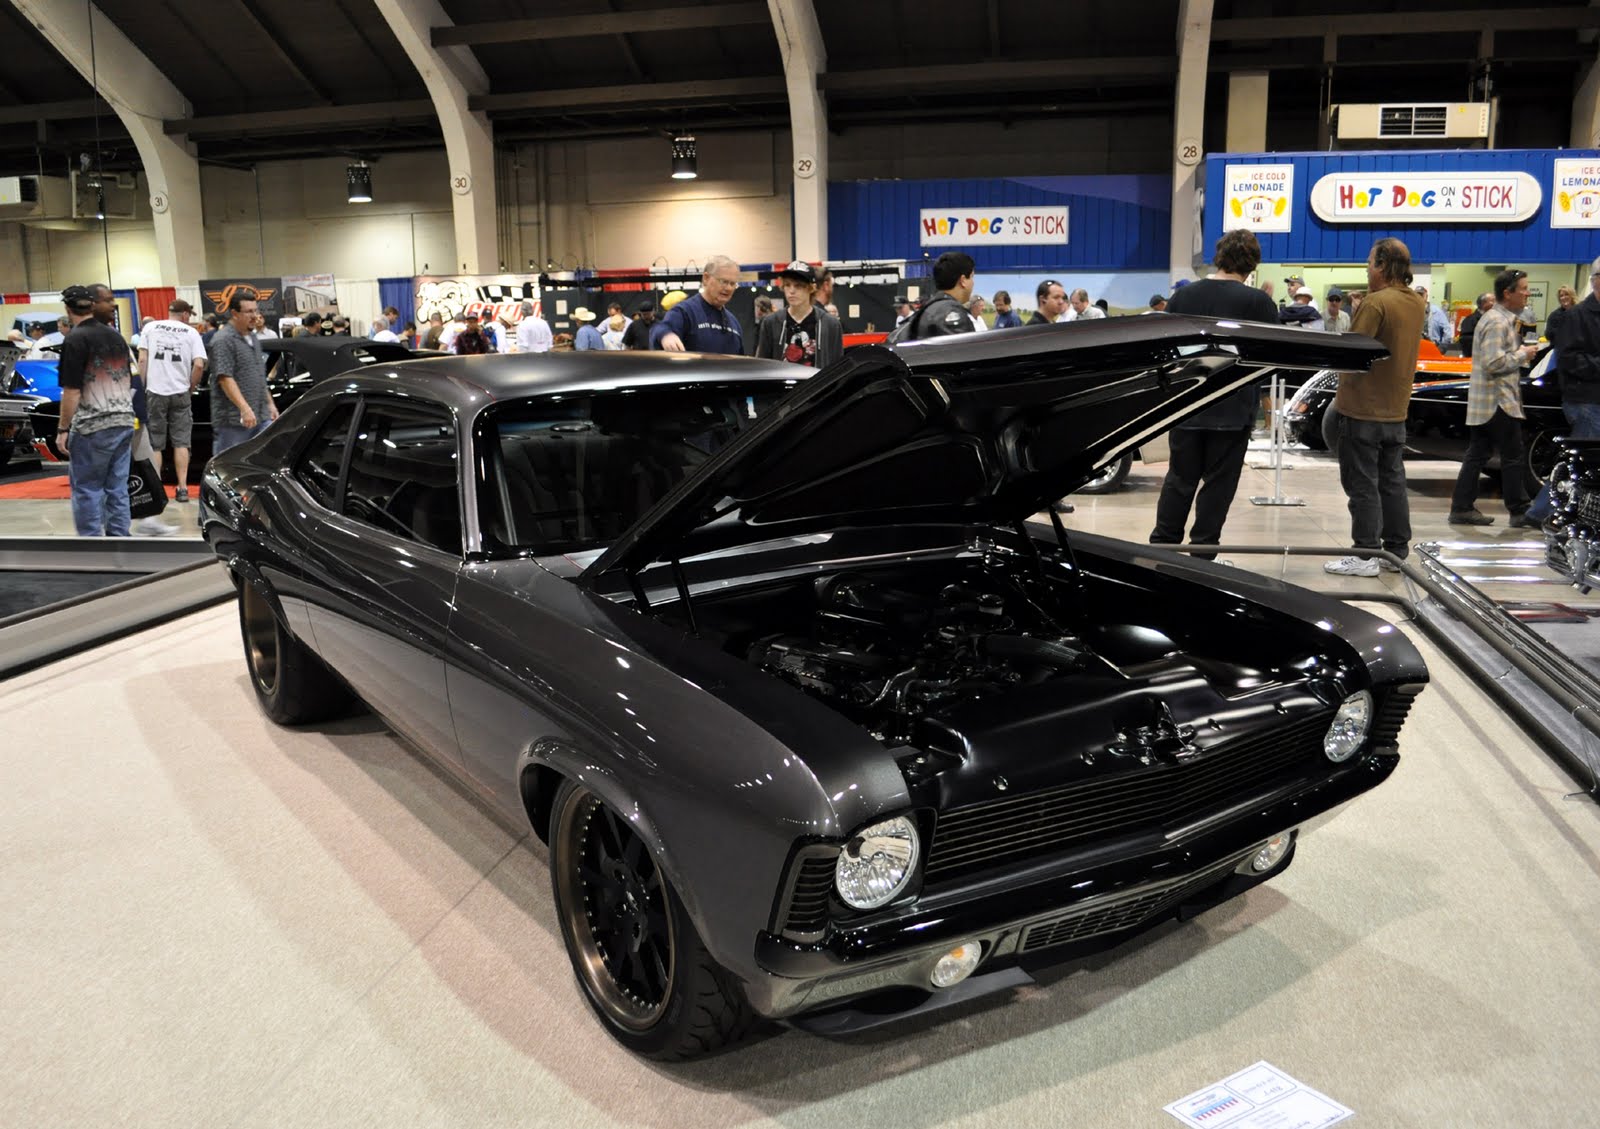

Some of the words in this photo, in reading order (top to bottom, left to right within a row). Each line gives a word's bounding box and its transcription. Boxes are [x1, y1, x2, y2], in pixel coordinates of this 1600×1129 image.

[1183, 145, 1198, 158] 28
[798, 159, 812, 171] 29
[1581, 166, 1594, 175] ICE
[454, 176, 467, 188] 30
[1251, 172, 1264, 180] ICE
[1266, 172, 1286, 180] COLD
[1233, 182, 1285, 192] LEMONADE
[1441, 186, 1456, 197] ON
[154, 196, 164, 207] 31
[1340, 184, 1383, 209] HOT
[1392, 185, 1436, 208] DOG
[1461, 185, 1513, 209] STICK
[1445, 198, 1452, 208] A
[965, 217, 1004, 236] DOG
[1008, 216, 1021, 225] ON
[1023, 215, 1065, 235] STICK
[922, 217, 959, 237] HOT
[1012, 226, 1018, 235] A
